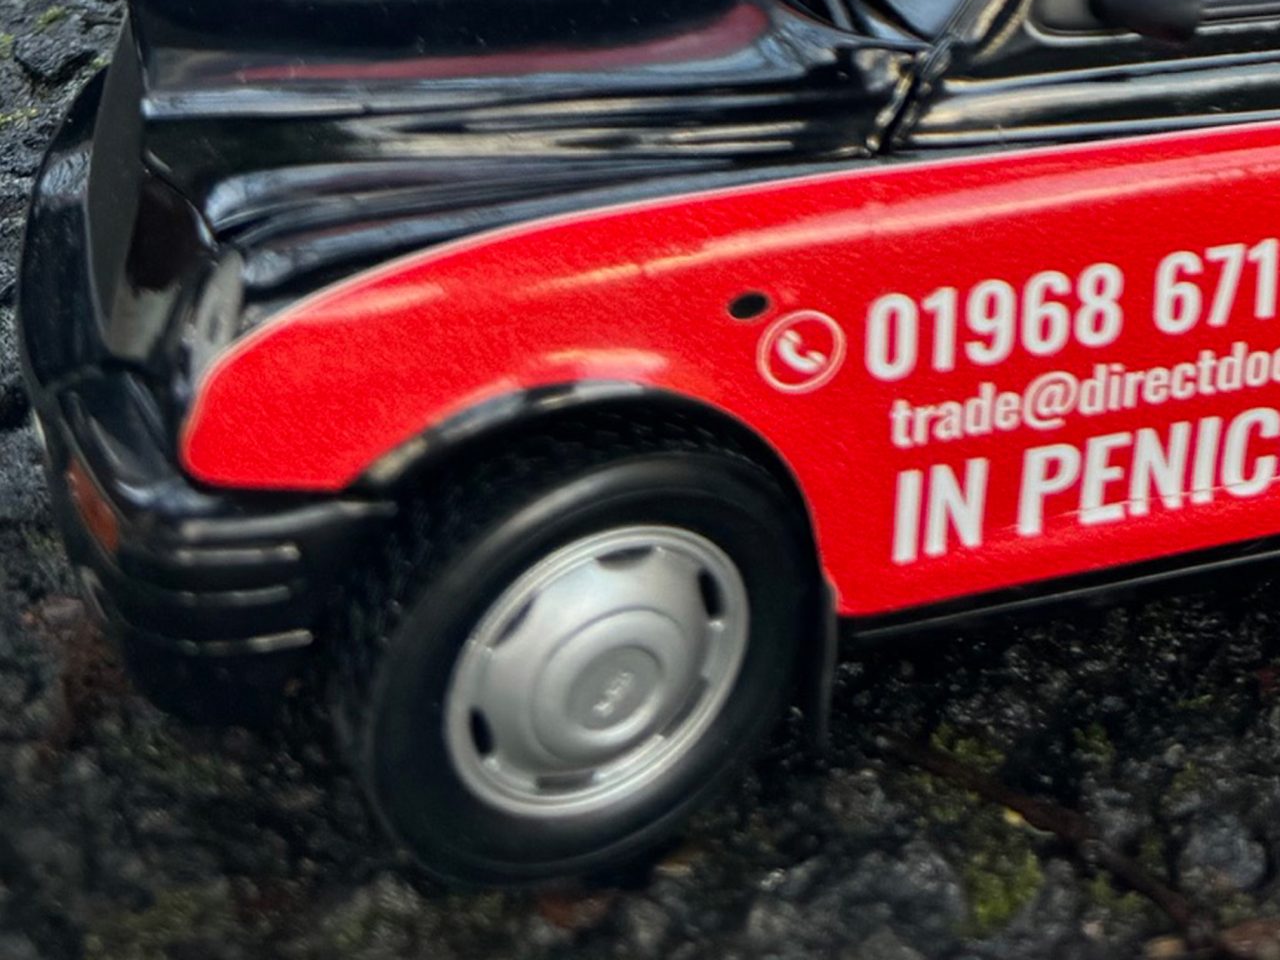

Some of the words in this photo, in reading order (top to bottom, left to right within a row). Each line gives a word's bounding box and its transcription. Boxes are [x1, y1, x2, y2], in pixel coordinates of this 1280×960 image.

[866, 263, 1123, 381] 01968
[1154, 237, 1280, 334] 671
[892, 458, 989, 564] IN
